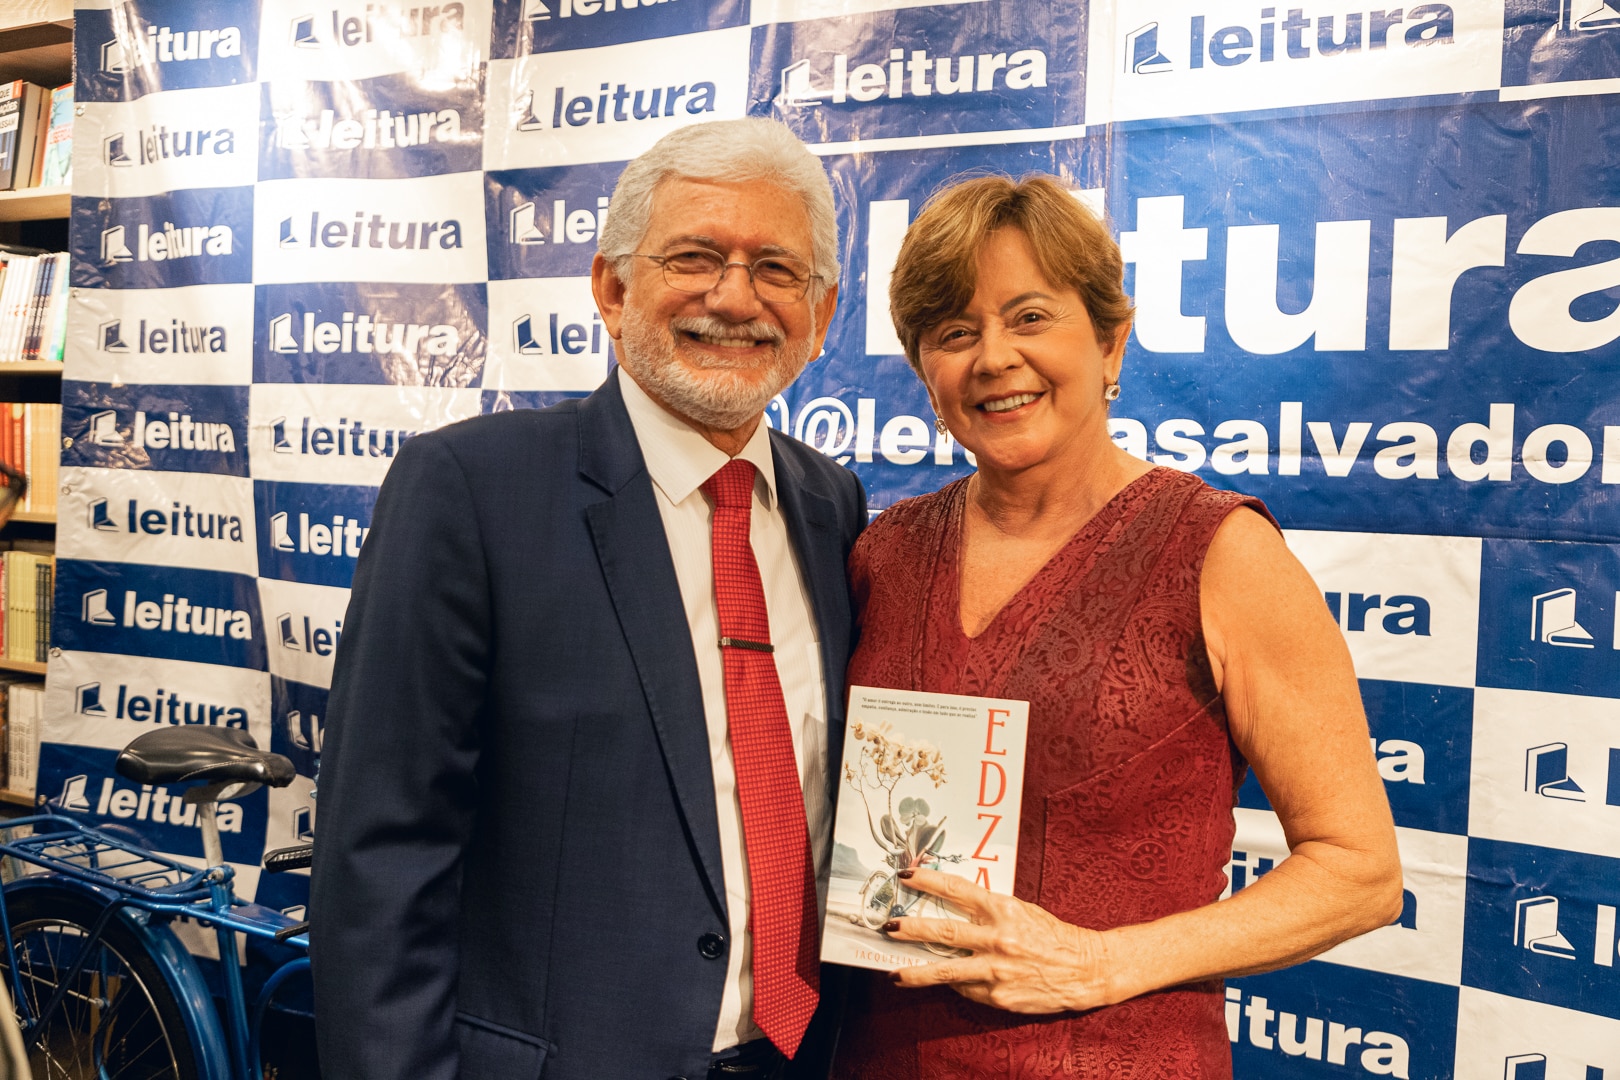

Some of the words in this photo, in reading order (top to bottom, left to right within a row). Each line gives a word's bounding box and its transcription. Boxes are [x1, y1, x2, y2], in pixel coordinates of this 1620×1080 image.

[1189, 3, 1455, 69] leitura
[831, 48, 1048, 103] leitura
[552, 80, 716, 129] leitura
[139, 124, 235, 166] leitura
[320, 108, 462, 150] leitura
[138, 221, 233, 262] leitura
[310, 211, 463, 250] leitura
[139, 319, 228, 354] leitura
[303, 312, 458, 356] leitura
[134, 411, 236, 453] leitura
[128, 499, 244, 543] leitura
[123, 590, 252, 640] leitura
[116, 685, 249, 730] leitura
[1225, 986, 1410, 1080] itura
